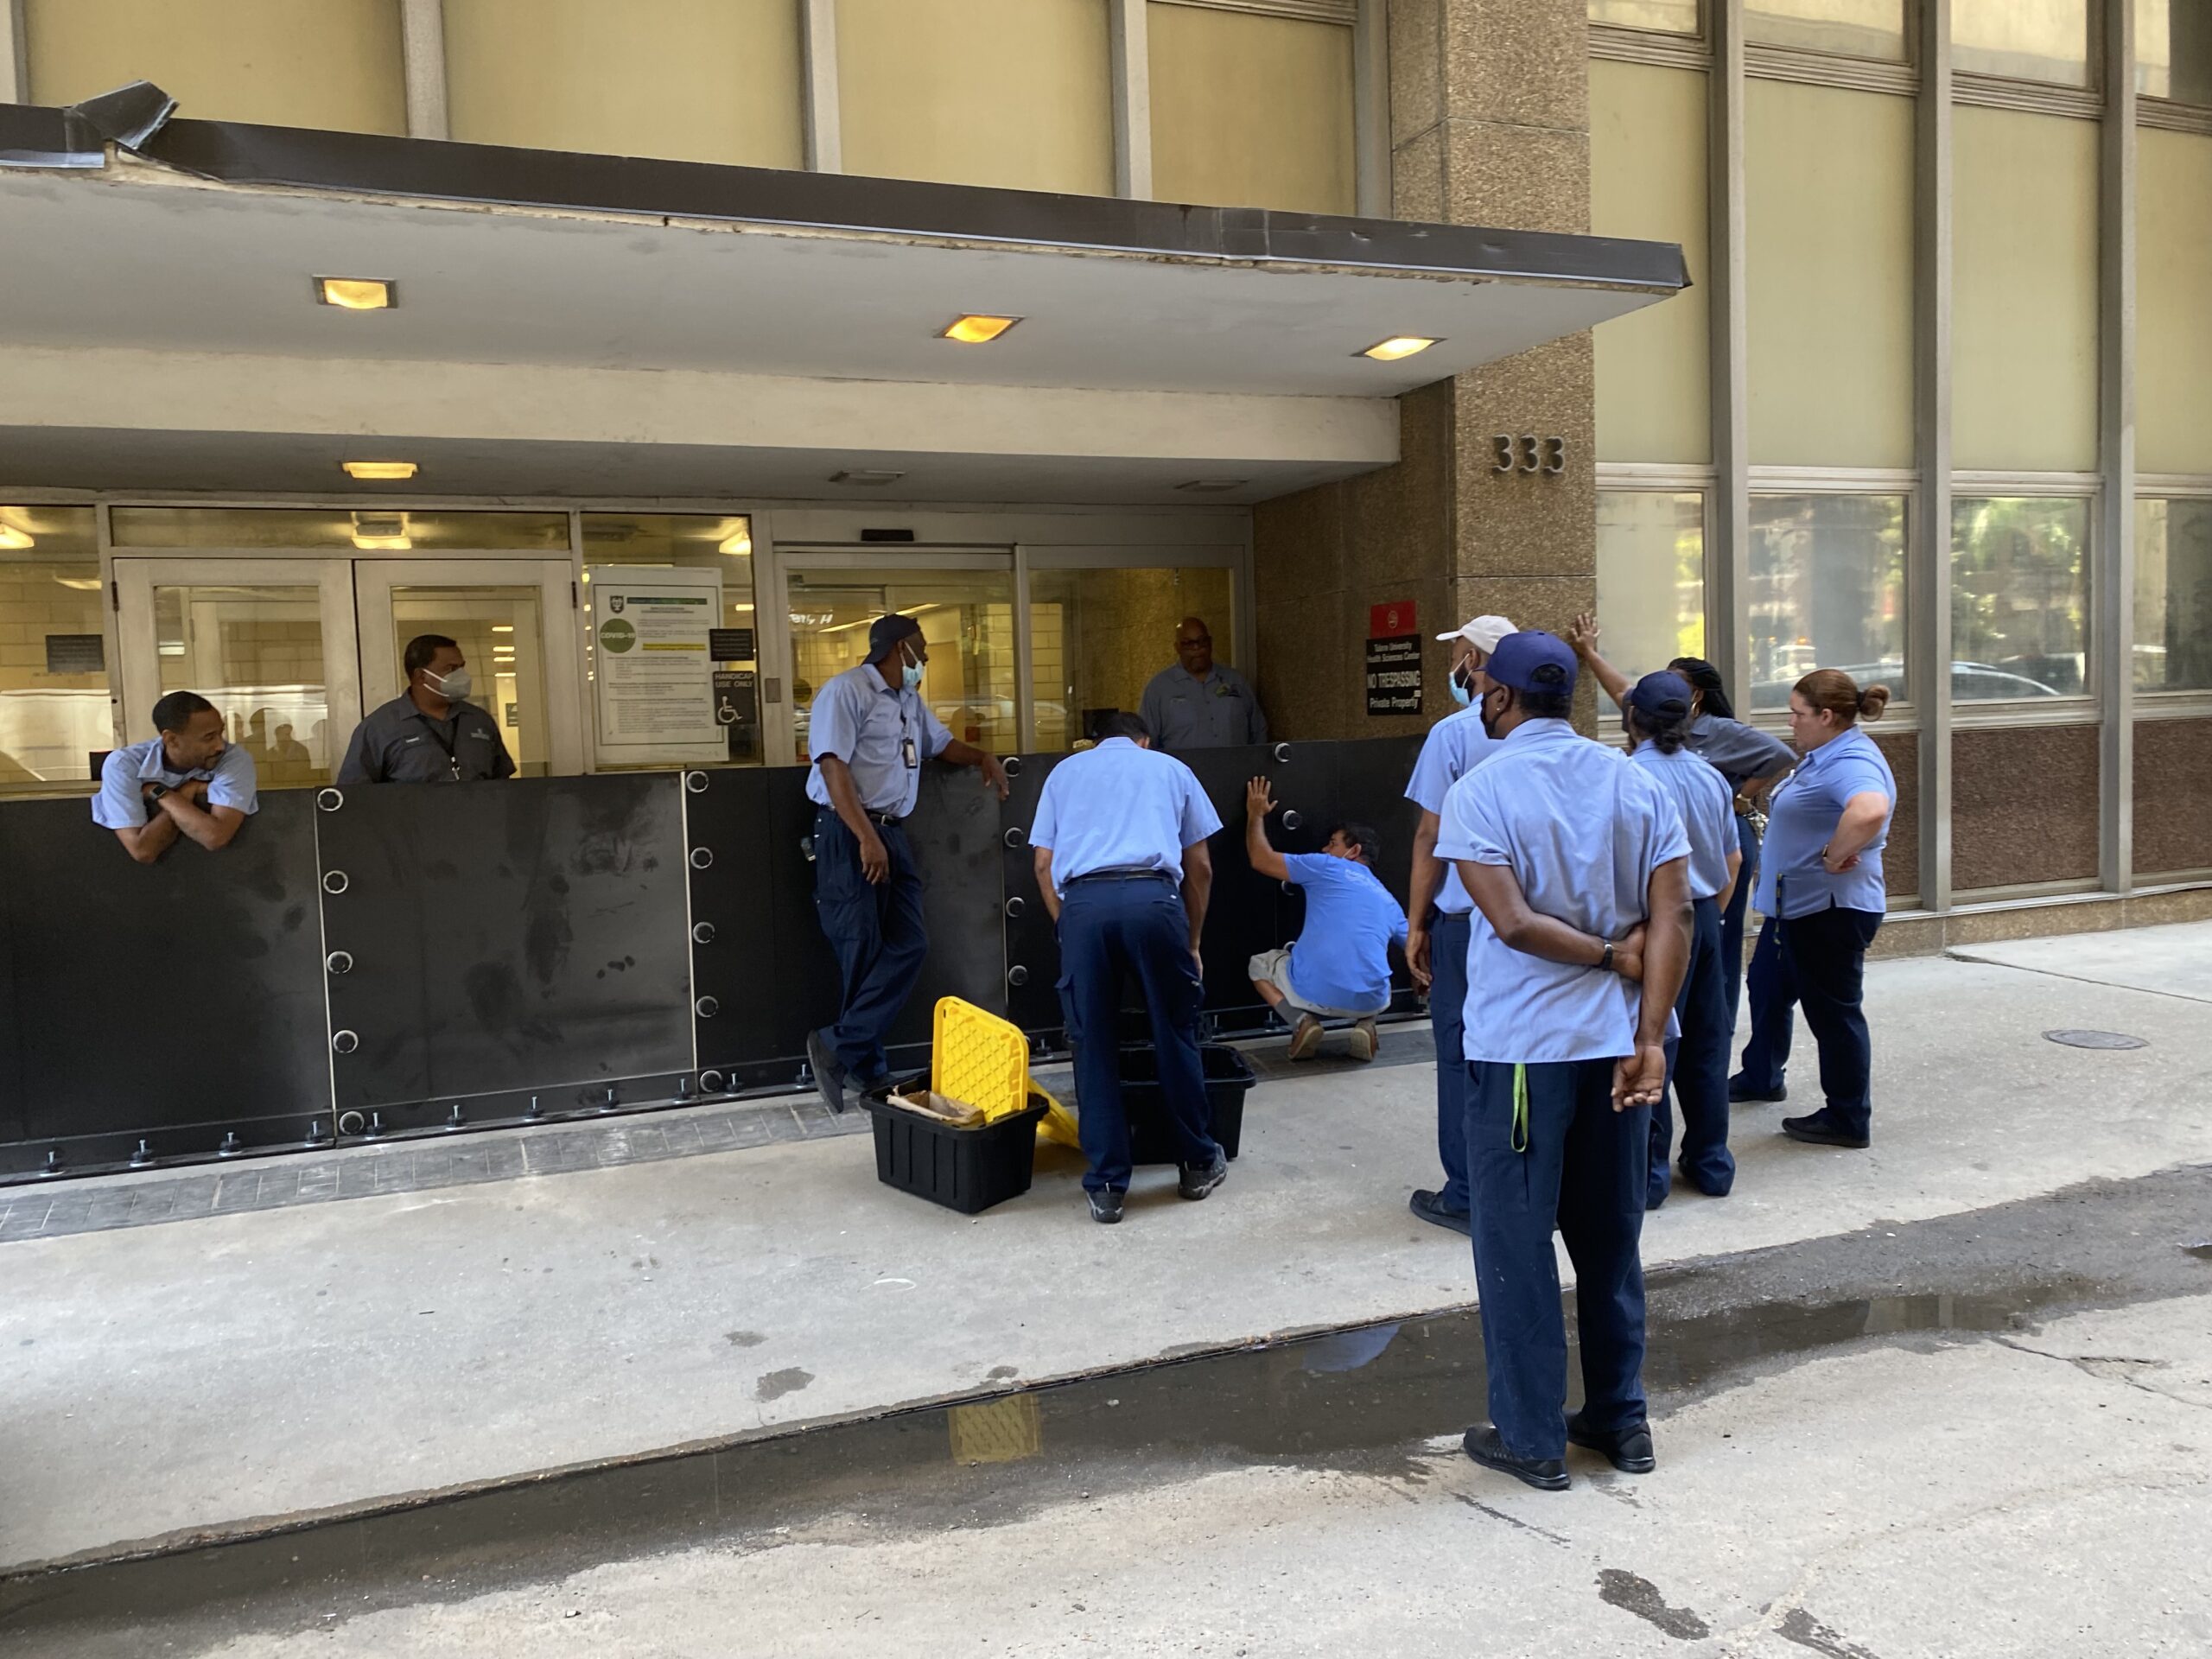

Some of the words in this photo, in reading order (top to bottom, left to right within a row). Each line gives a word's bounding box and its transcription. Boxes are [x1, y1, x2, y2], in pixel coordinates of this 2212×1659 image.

[1492, 434, 1565, 473] 333
[1367, 673, 1377, 689] NO
[1378, 671, 1421, 688] TRESPASSING
[1370, 697, 1390, 708] Private
[1391, 696, 1418, 709] Property
